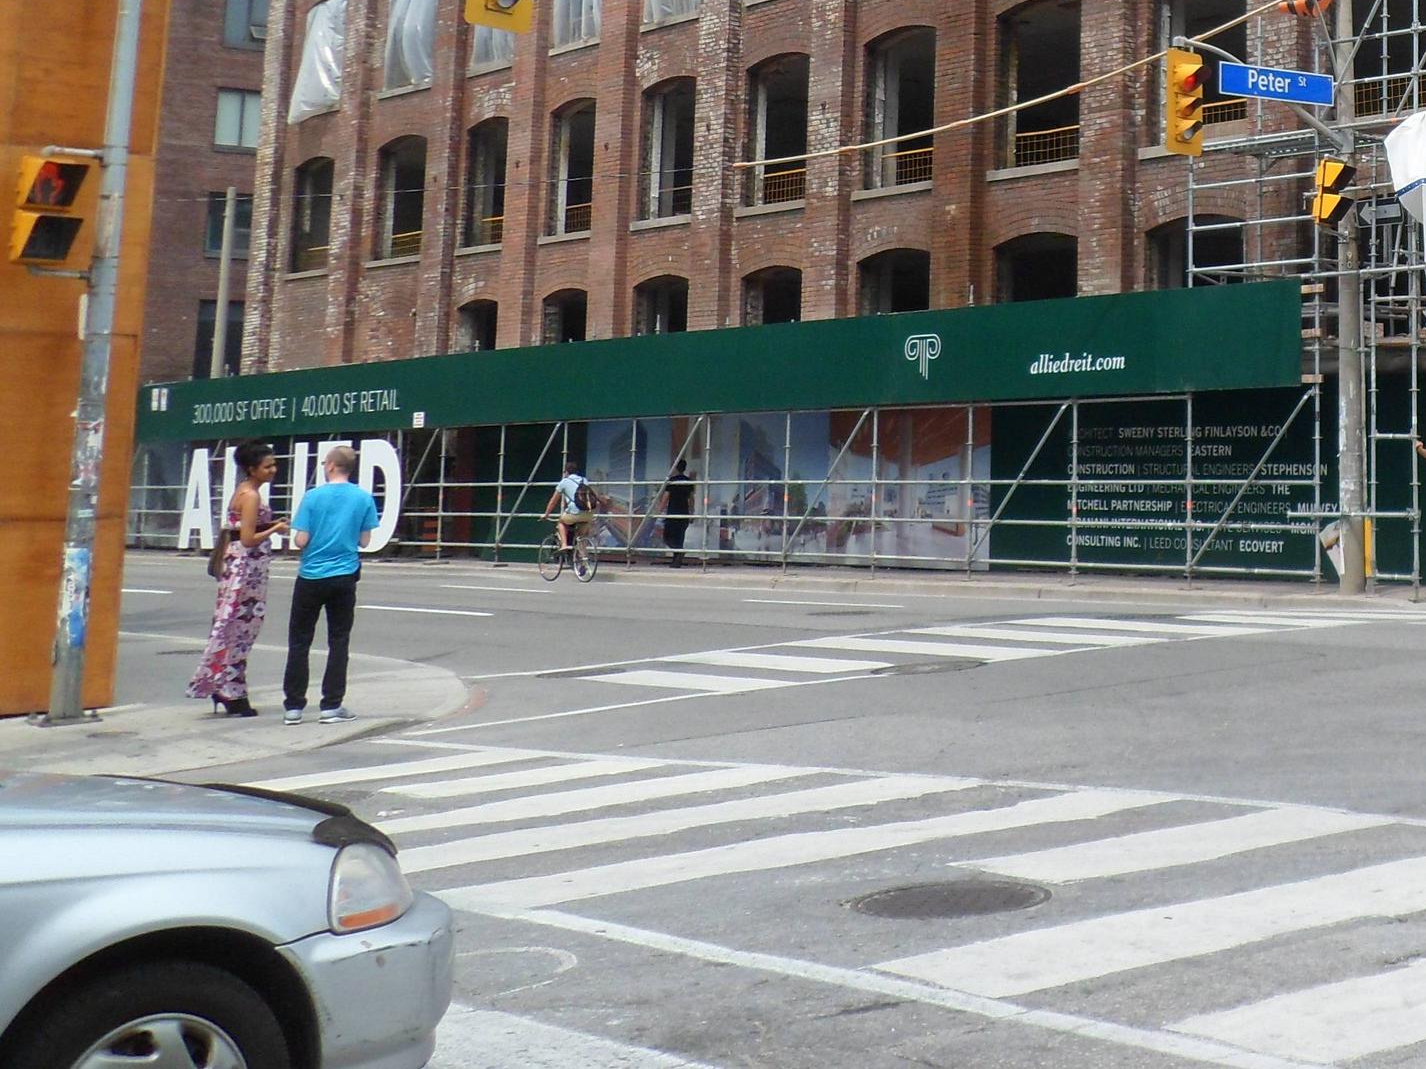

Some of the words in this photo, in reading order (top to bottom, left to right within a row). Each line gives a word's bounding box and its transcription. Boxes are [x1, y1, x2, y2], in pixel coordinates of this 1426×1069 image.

[1248, 69, 1291, 93] Peter
[1298, 76, 1307, 87] St
[1030, 352, 1126, 374] alliedreit.com
[192, 401, 234, 425] 300,000
[235, 401, 249, 422] SF
[250, 398, 287, 421] OFFICE
[301, 393, 340, 417] 40,000
[342, 392, 358, 413] SF
[359, 389, 400, 412] RETAIL
[1118, 427, 1155, 438] SWEENY
[1204, 426, 1258, 438] FINLAYSON
[1068, 464, 1136, 475] CNSTRUCTION
[1272, 484, 1291, 495] THE
[1111, 500, 1173, 512] PARTNERSHIP
[1238, 502, 1290, 514] ENGINEERS
[1123, 536, 1142, 548] INC.
[1149, 538, 1172, 549] LEED
[1240, 540, 1284, 553] ECOVERT
